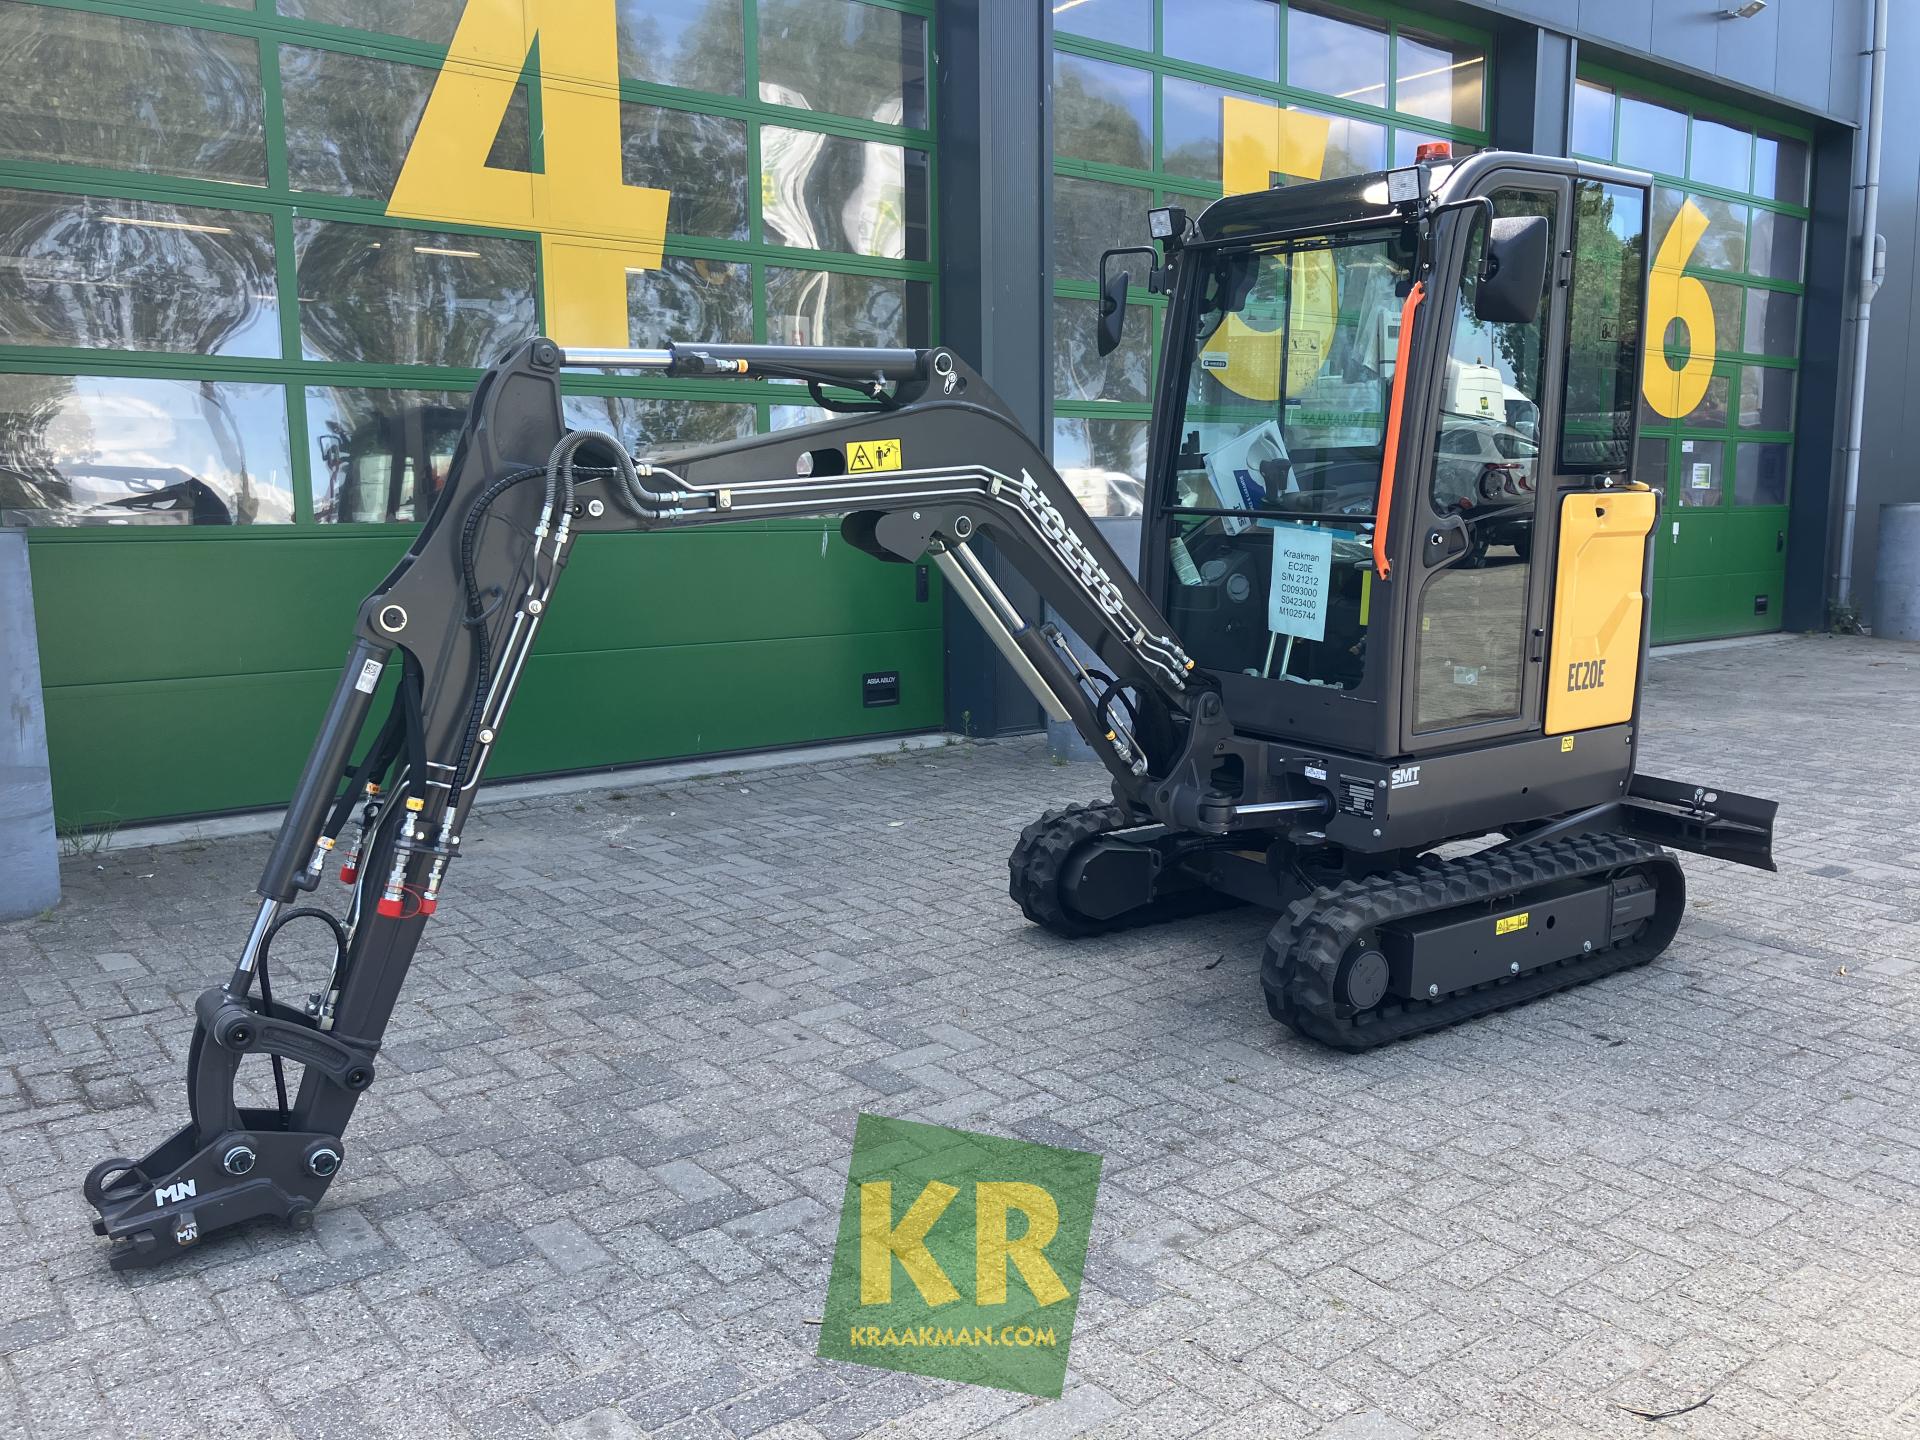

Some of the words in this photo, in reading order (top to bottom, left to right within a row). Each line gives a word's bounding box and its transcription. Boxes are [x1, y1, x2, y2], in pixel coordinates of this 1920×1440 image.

[384, 0, 671, 349] 4
[1642, 197, 1716, 418] 6
[1020, 467, 1123, 615] VOLVO
[1283, 549, 1320, 562] Kraakman
[1288, 561, 1313, 573] EC20E
[1281, 572, 1295, 582] S/N
[1296, 574, 1319, 586] 21212
[1281, 584, 1318, 597] C0093000
[1281, 595, 1317, 609] S0423400
[1279, 606, 1316, 621] M1025744
[1567, 659, 1606, 692] EC20E
[1391, 765, 1421, 785] SMT
[155, 1179, 197, 1207] MN
